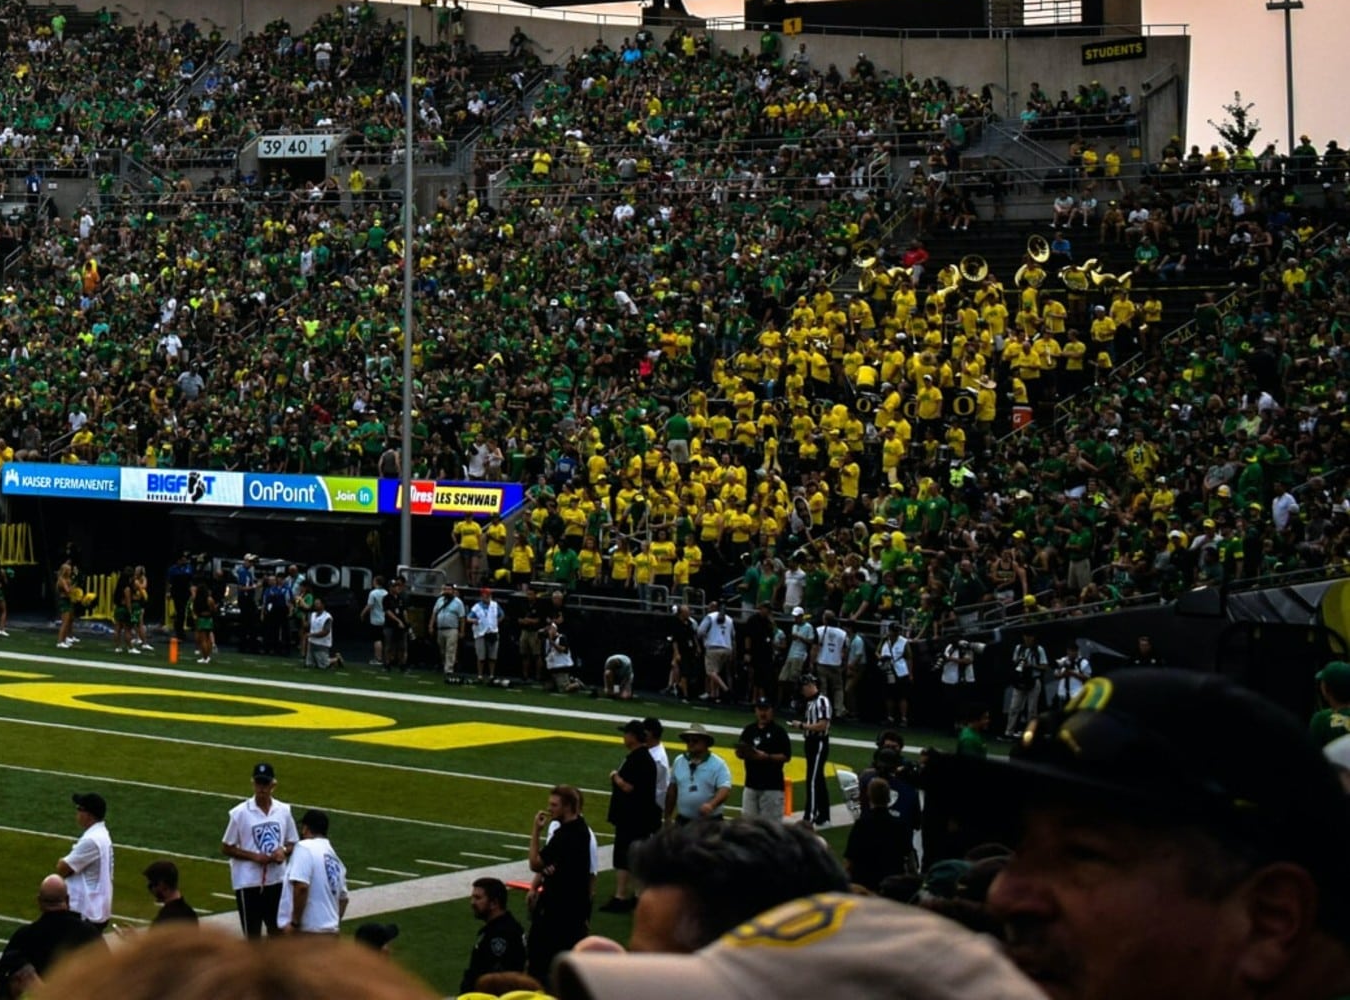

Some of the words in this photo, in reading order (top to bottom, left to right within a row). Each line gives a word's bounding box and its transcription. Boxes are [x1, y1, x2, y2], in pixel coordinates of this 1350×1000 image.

[1085, 43, 1143, 60] STUDENTS
[263, 140, 282, 155] 39
[288, 140, 307, 154] 40
[22, 476, 52, 489] KAISER
[54, 476, 114, 491] PERMANENTE
[250, 480, 315, 503] OnPoint
[335, 489, 356, 501] Join
[360, 490, 369, 502] in
[435, 492, 452, 505] LES
[453, 492, 498, 507] SCHWAB
